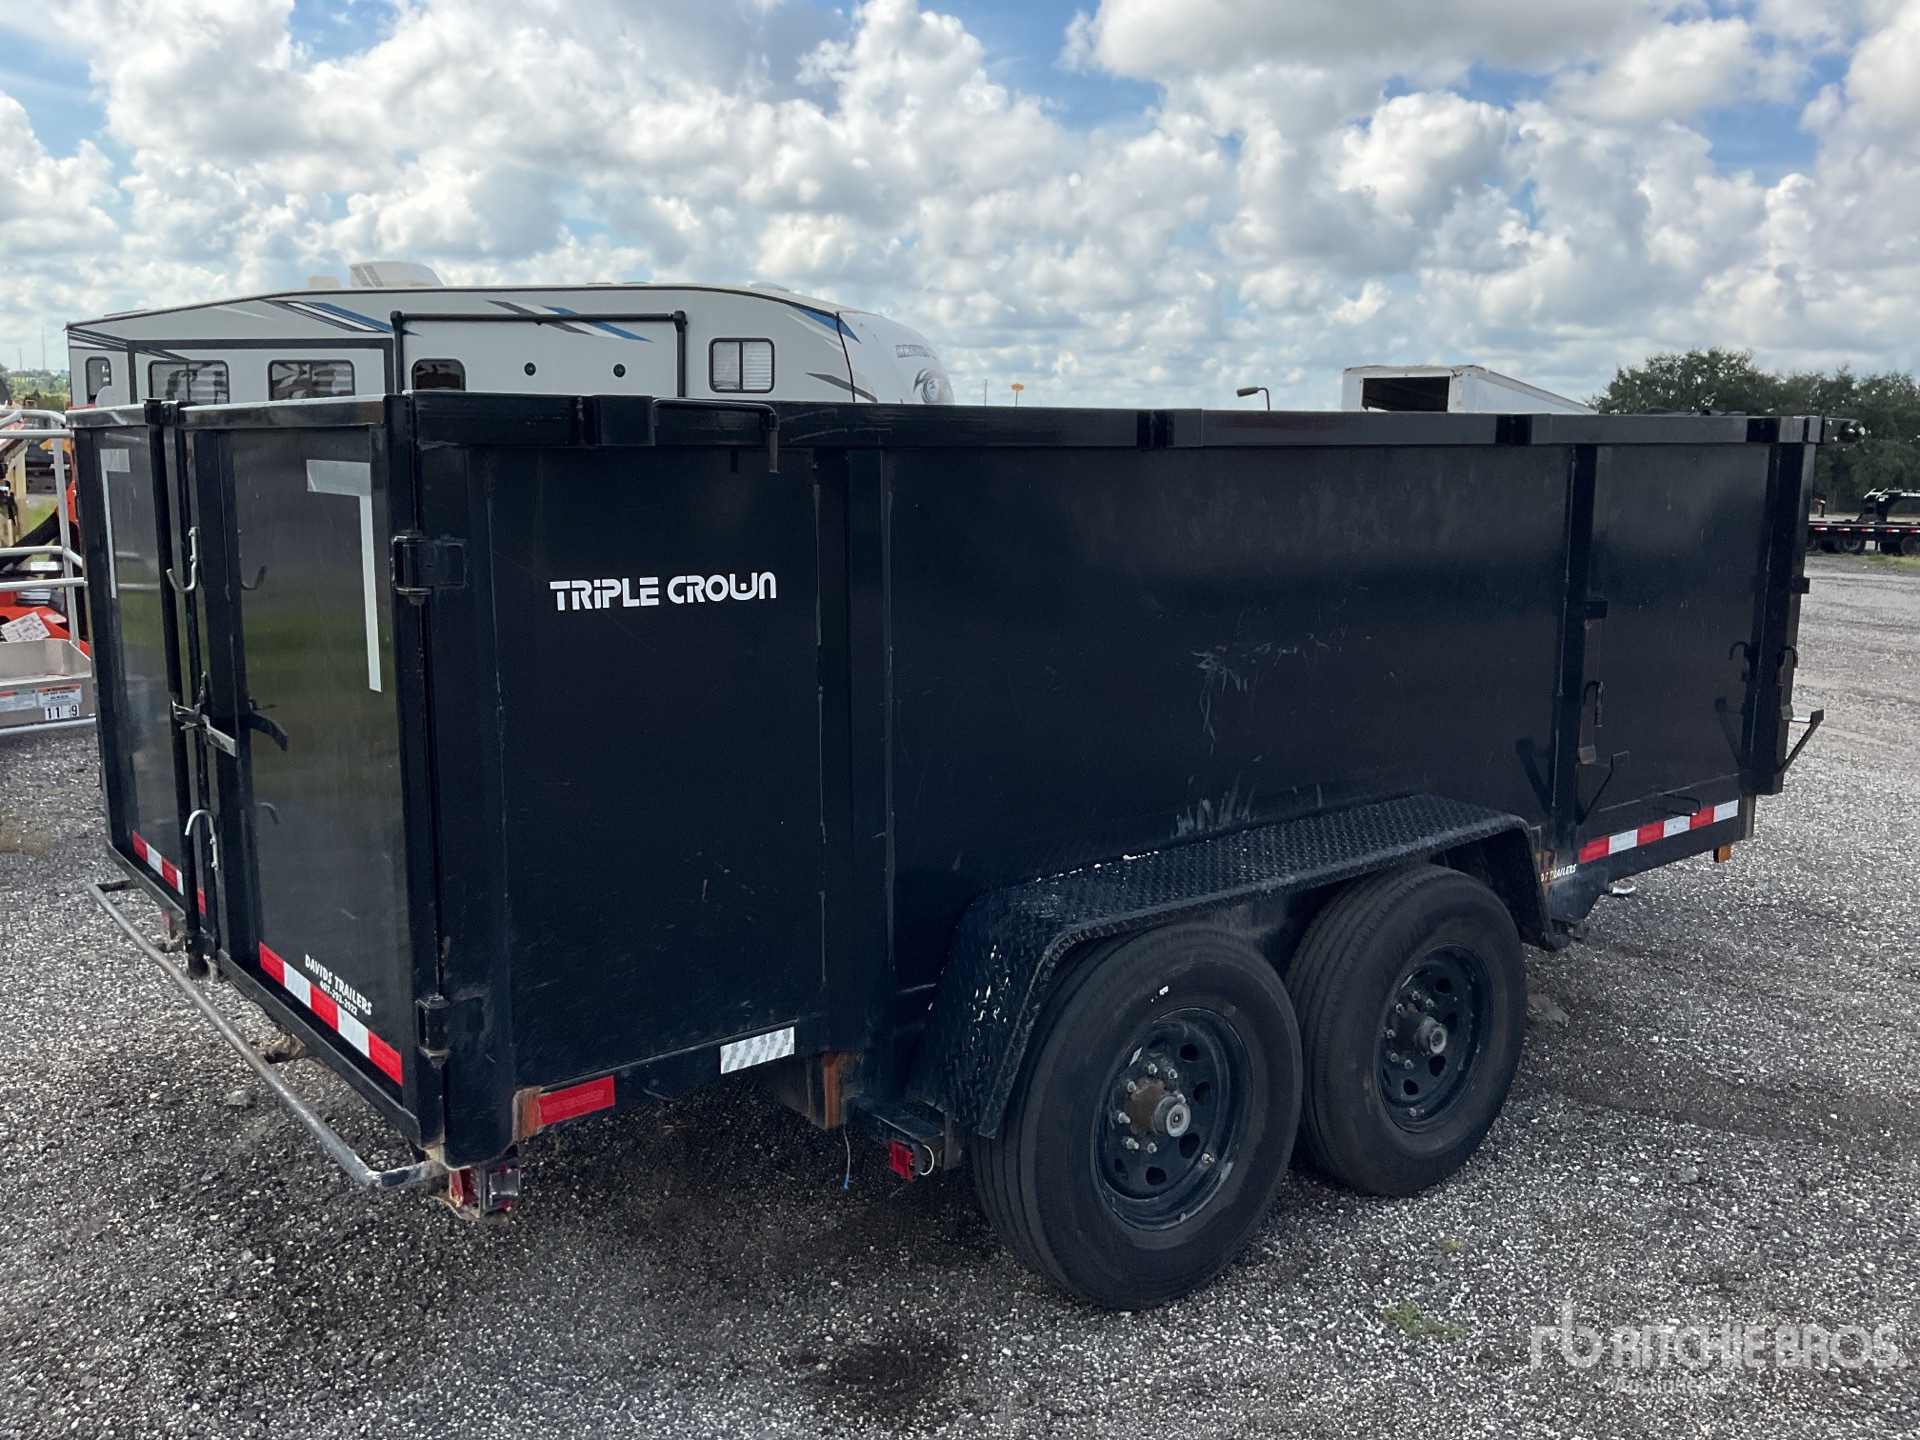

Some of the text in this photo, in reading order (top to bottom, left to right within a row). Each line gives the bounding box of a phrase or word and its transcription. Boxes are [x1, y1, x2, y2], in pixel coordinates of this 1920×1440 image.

[549, 571, 777, 611] TRIPLE CROWN
[305, 953, 373, 1016] DAVIDS TRAILERS
